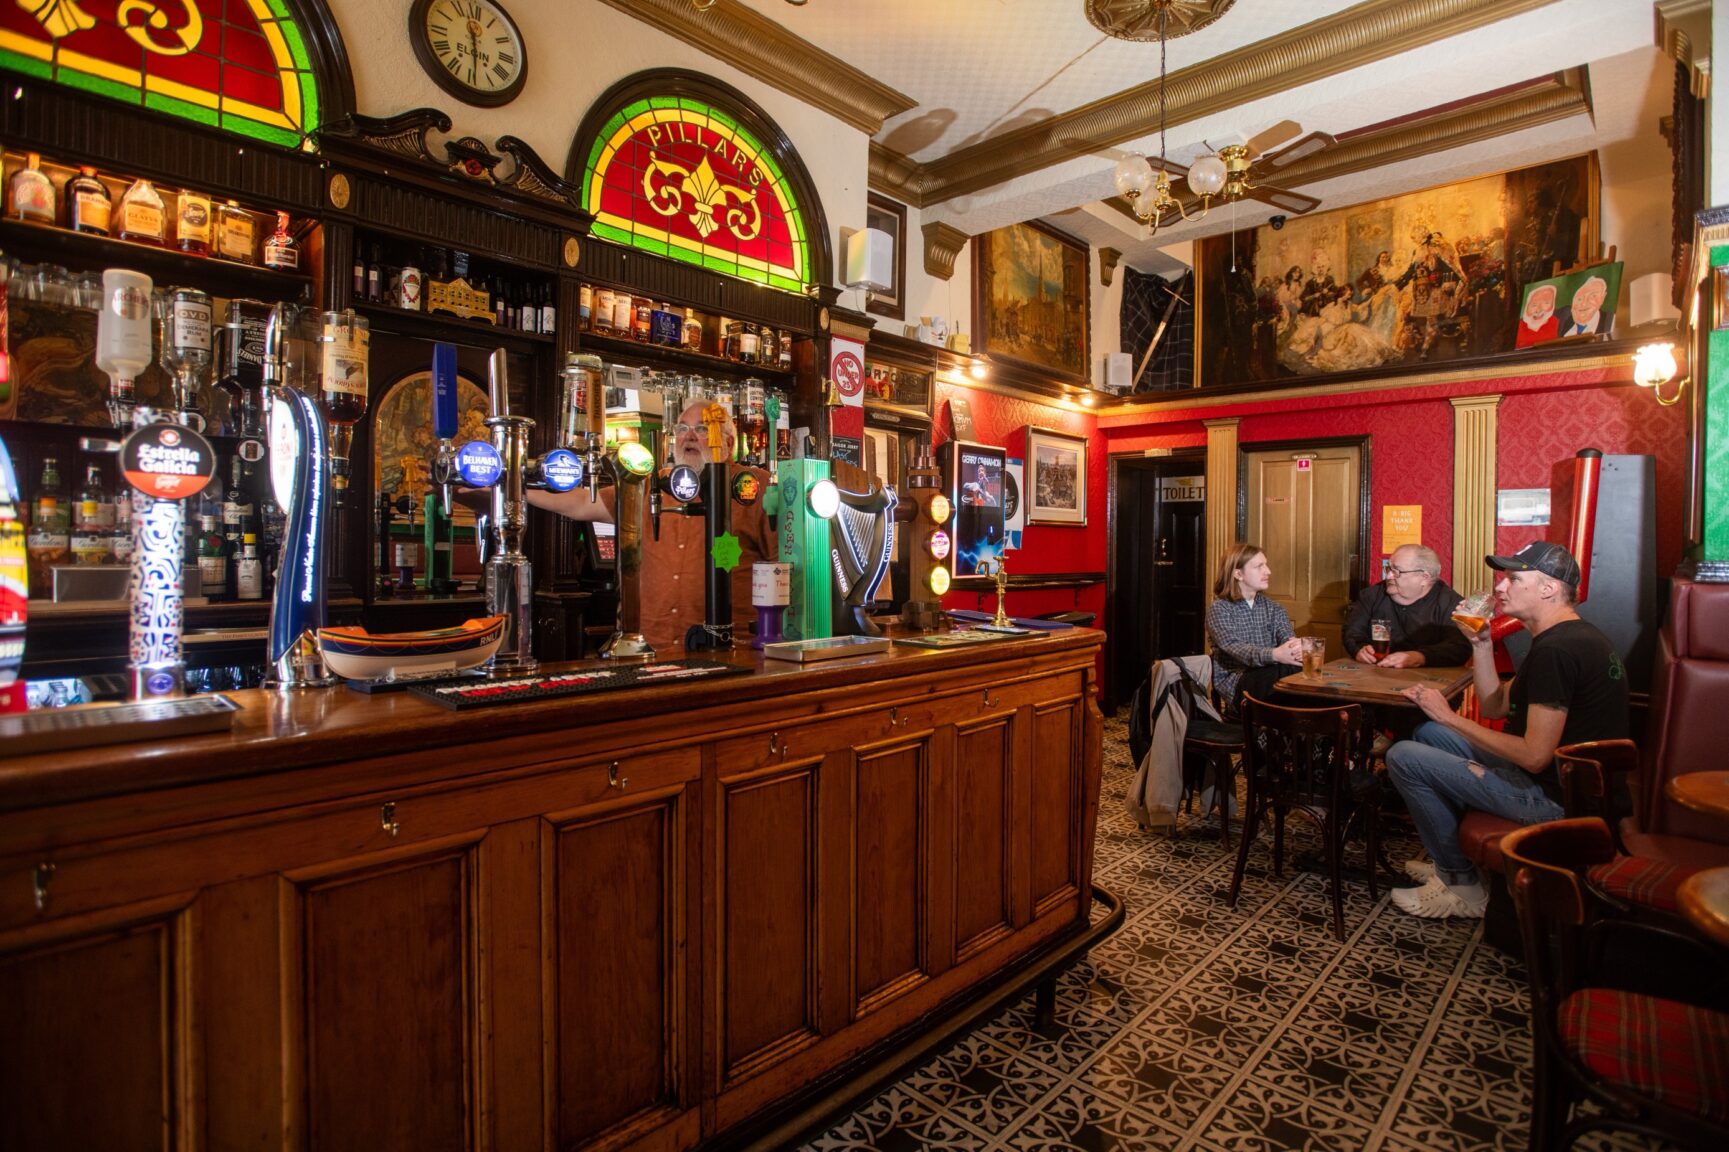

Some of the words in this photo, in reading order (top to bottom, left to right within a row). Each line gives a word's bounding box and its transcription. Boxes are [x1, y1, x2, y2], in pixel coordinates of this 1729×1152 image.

[456, 42, 489, 63] ELGIN
[647, 122, 764, 187] PILLARS
[843, 358, 854, 368] NO
[837, 369, 859, 380] UNDER
[842, 380, 851, 389] 25
[137, 443, 200, 463] Estrella
[462, 455, 498, 467] BELHAVEN
[138, 458, 198, 475] Galicia
[469, 465, 491, 474] BEST
[1162, 486, 1205, 500] TOILET
[784, 510, 795, 556] HEAD
[883, 522, 895, 563] GUINNESS
[831, 548, 849, 594] GUINNESS
[479, 630, 499, 647] RNLI
